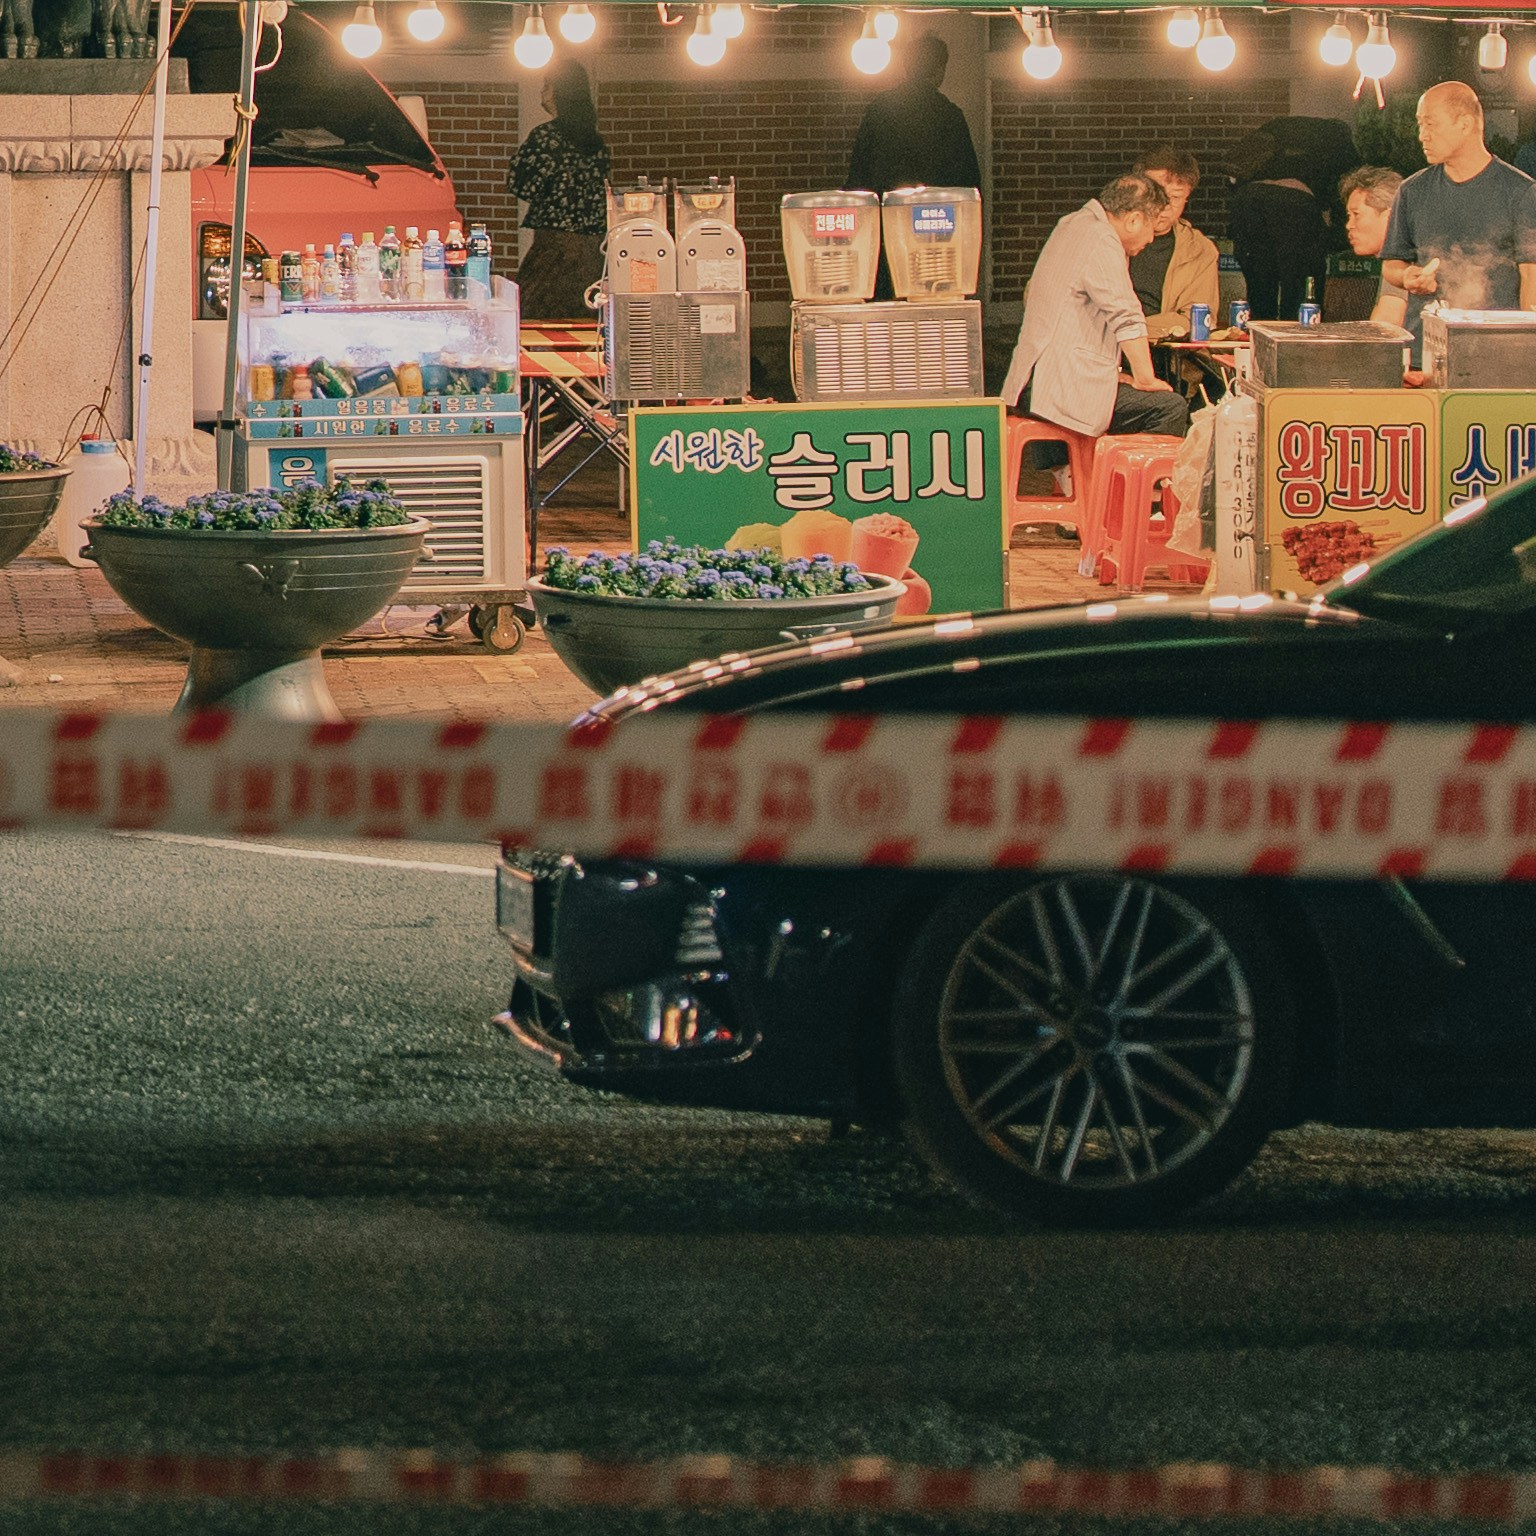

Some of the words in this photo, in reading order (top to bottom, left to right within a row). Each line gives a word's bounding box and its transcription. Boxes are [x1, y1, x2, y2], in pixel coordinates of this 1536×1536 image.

[314, 420, 366, 436] 시원한
[408, 418, 460, 434] 음료수
[446, 397, 496, 412] 음료수
[650, 427, 765, 474] 시원한
[766, 427, 986, 509] 슬러시
[1277, 421, 1427, 517] 왕꼬지
